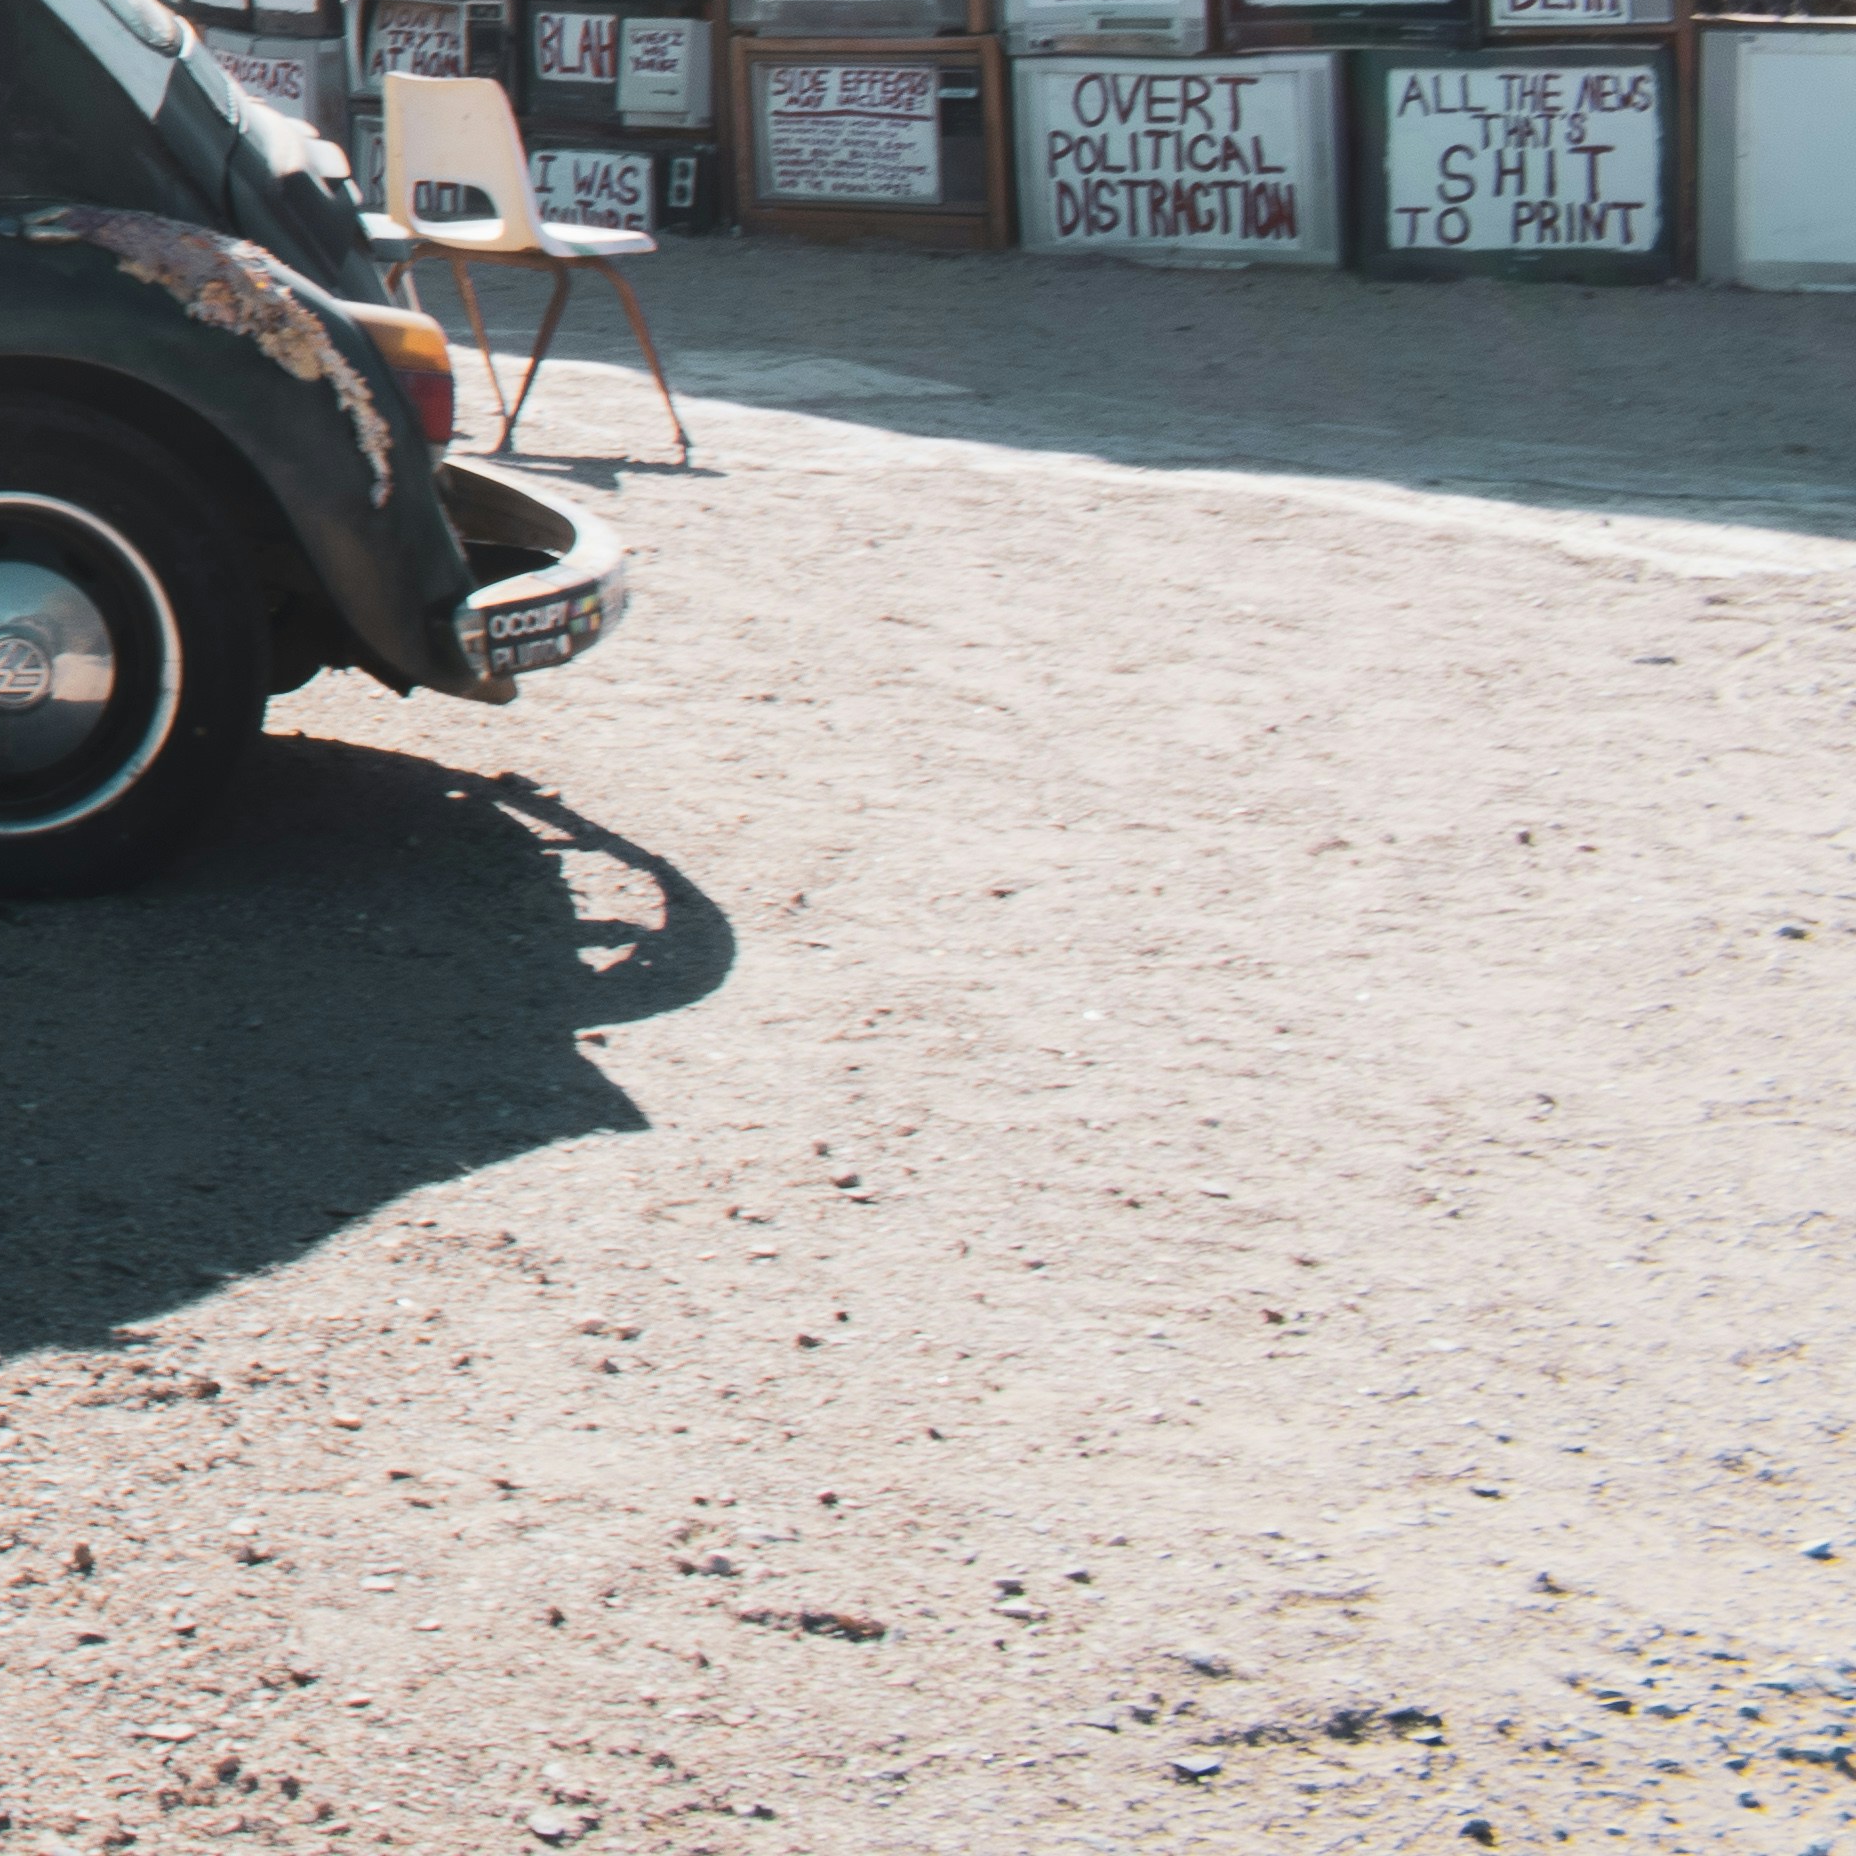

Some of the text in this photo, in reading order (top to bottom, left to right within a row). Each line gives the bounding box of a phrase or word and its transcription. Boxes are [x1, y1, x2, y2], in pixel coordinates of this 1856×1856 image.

[370, 47, 405, 76] AT
[539, 15, 617, 76] BLAH
[772, 68, 929, 97] SIDE EFFECTS
[1074, 74, 1258, 129] OVERT
[1396, 74, 1652, 117] ALL THE NEWS
[1048, 130, 1285, 178] POLITICAL
[1473, 113, 1586, 151] THAT'S
[535, 155, 639, 204] I WAS
[1438, 144, 1615, 205] SHIT
[1057, 178, 1297, 238] DISTRACTION
[1394, 199, 1645, 245] TO PRINT
